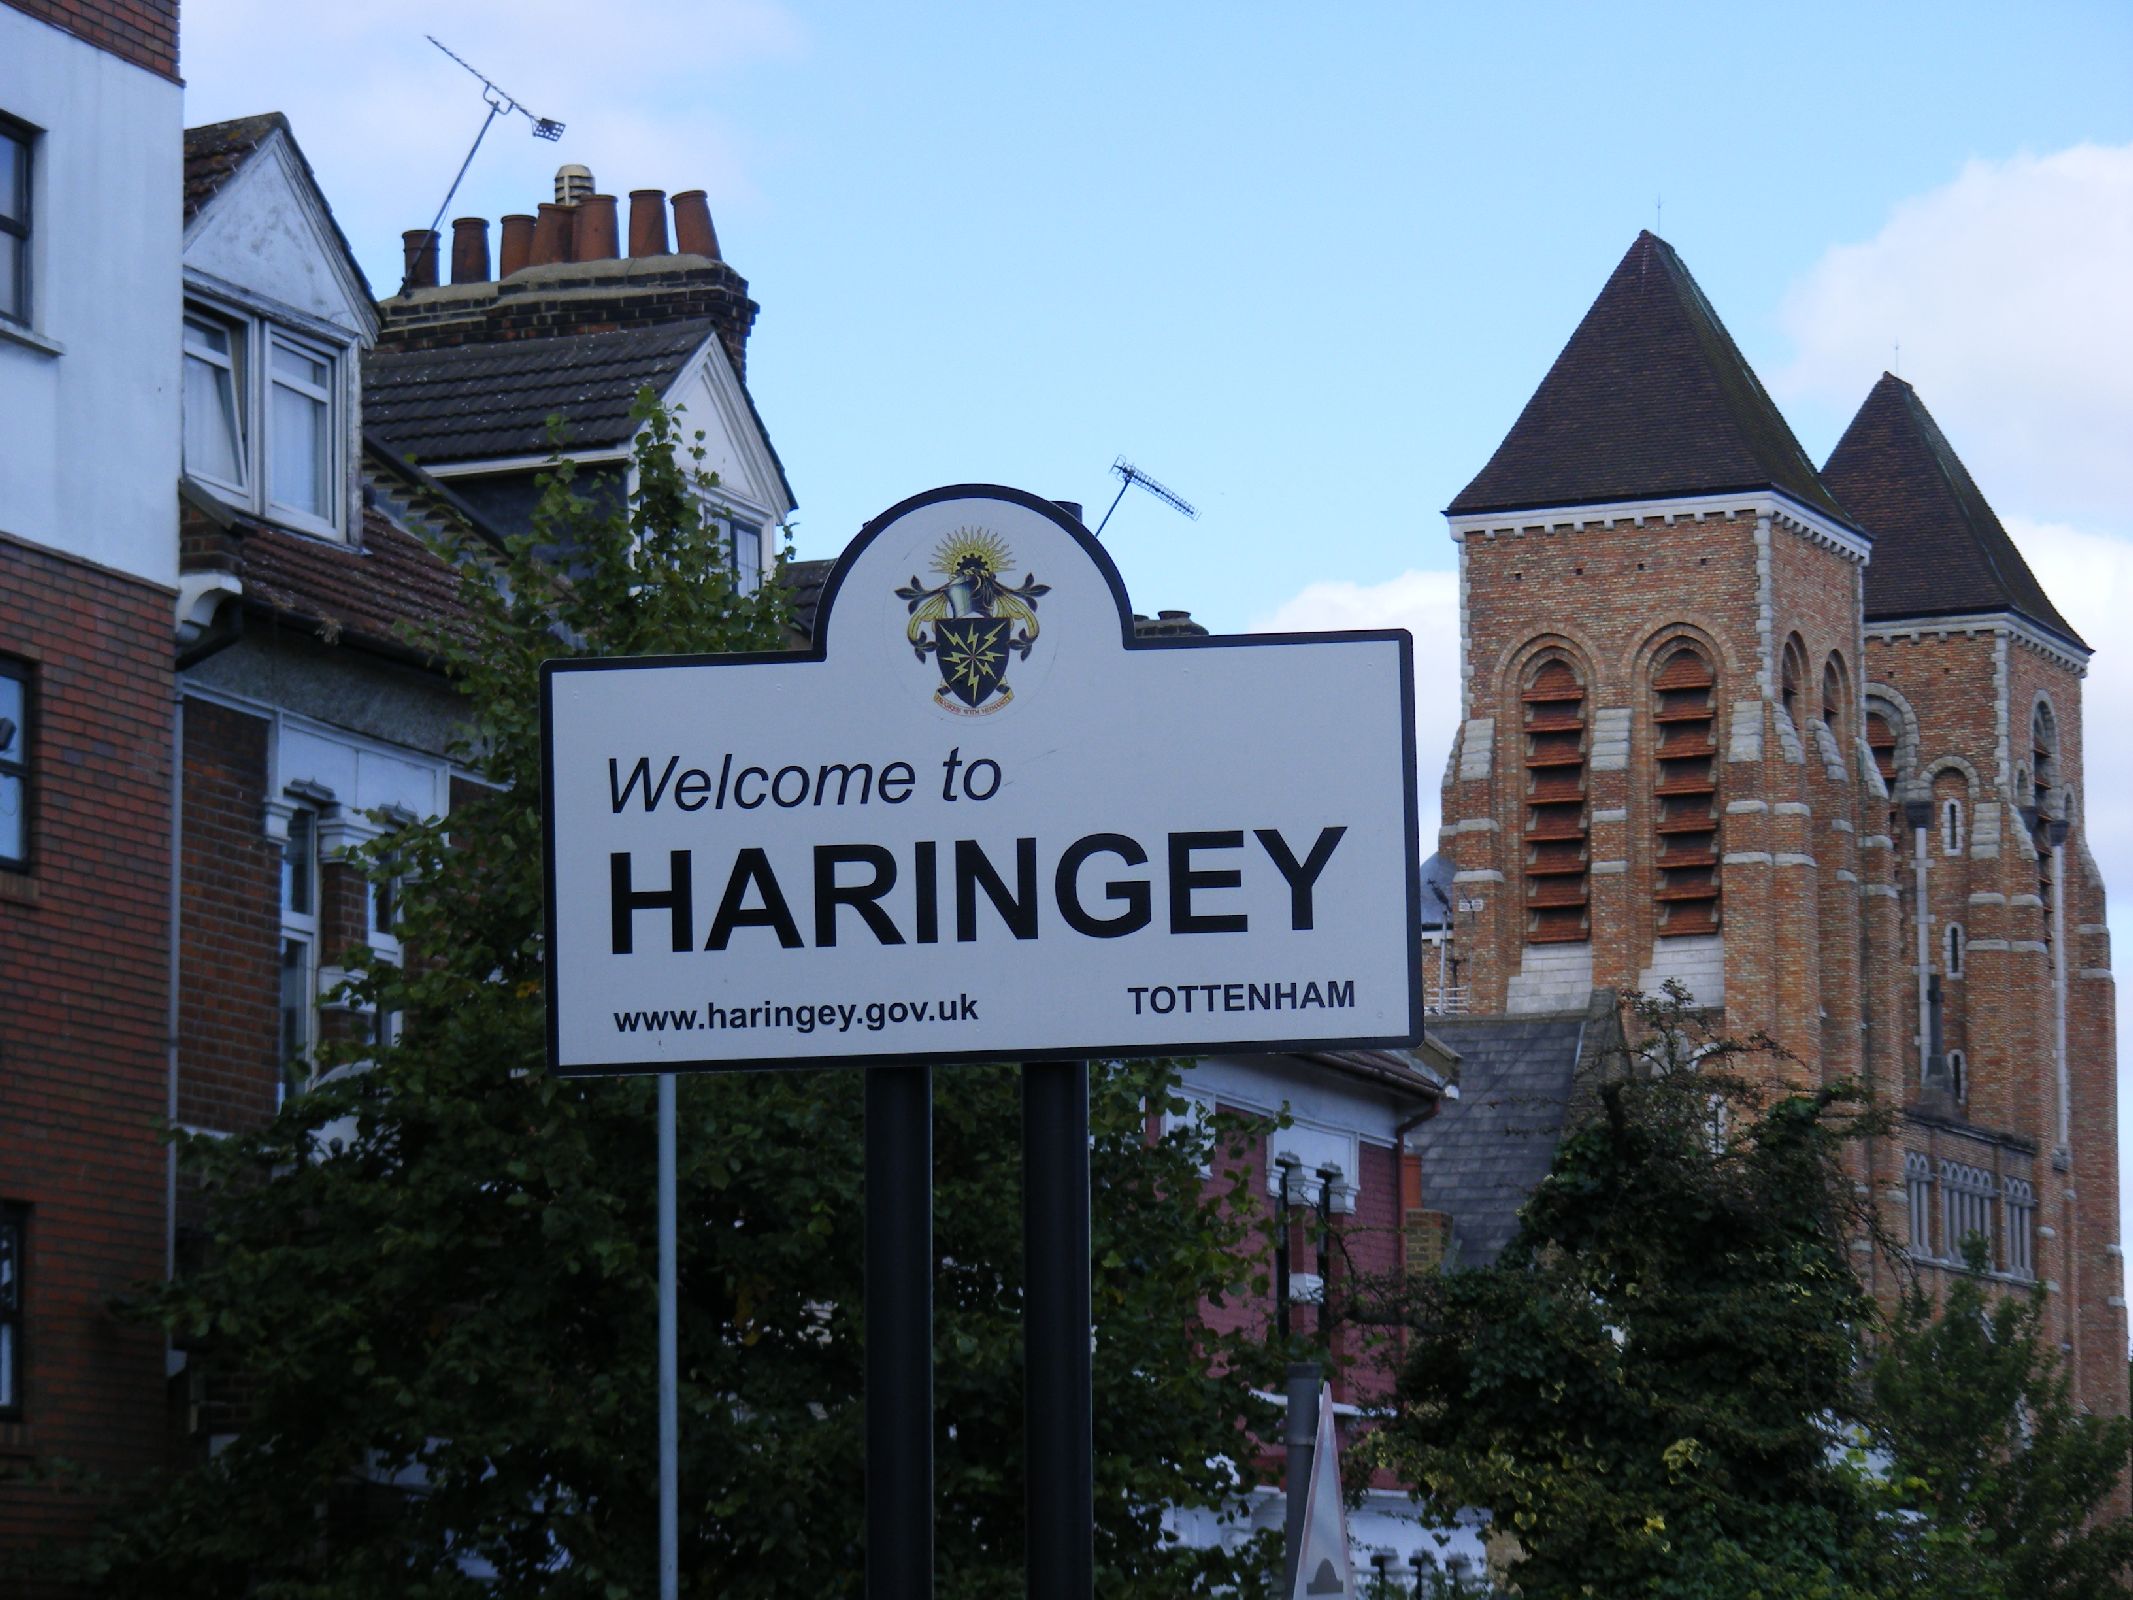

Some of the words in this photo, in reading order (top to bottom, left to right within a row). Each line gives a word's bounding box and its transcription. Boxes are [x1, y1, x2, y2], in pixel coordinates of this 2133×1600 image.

[607, 753, 917, 814] Welcome
[941, 746, 1003, 803] to
[608, 825, 1350, 957] HARINGEY
[611, 992, 981, 1035] www.haringey.gov.uk
[1126, 980, 1357, 1017] TOTTENHAM
